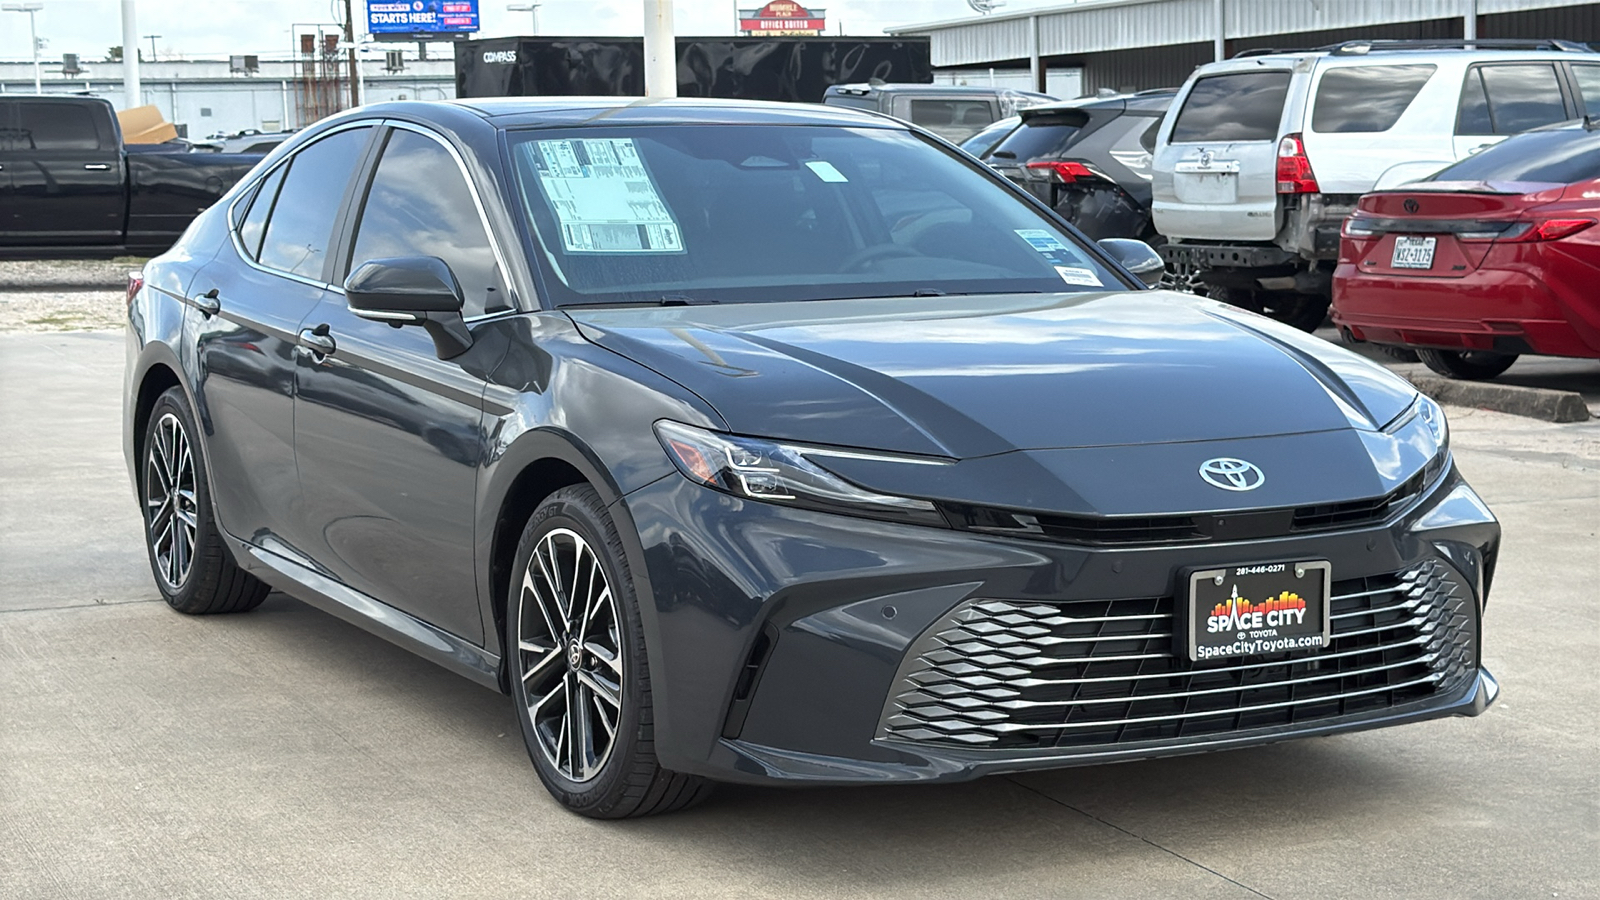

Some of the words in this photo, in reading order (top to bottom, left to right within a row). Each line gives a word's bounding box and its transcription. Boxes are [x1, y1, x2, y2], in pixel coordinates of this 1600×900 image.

[371, 12, 408, 24] STARTS
[409, 12, 437, 23] HERE!
[760, 20, 783, 29] OFFICE
[784, 20, 808, 29] SUITES
[483, 50, 517, 63] COMPASS
[1235, 564, 1285, 576] 281-446-0271
[1207, 611, 1264, 633] SPACE
[1266, 607, 1307, 627] CITY
[1249, 629, 1278, 639] TOYOTA
[1197, 635, 1323, 659] SpaceCityToyota.com
